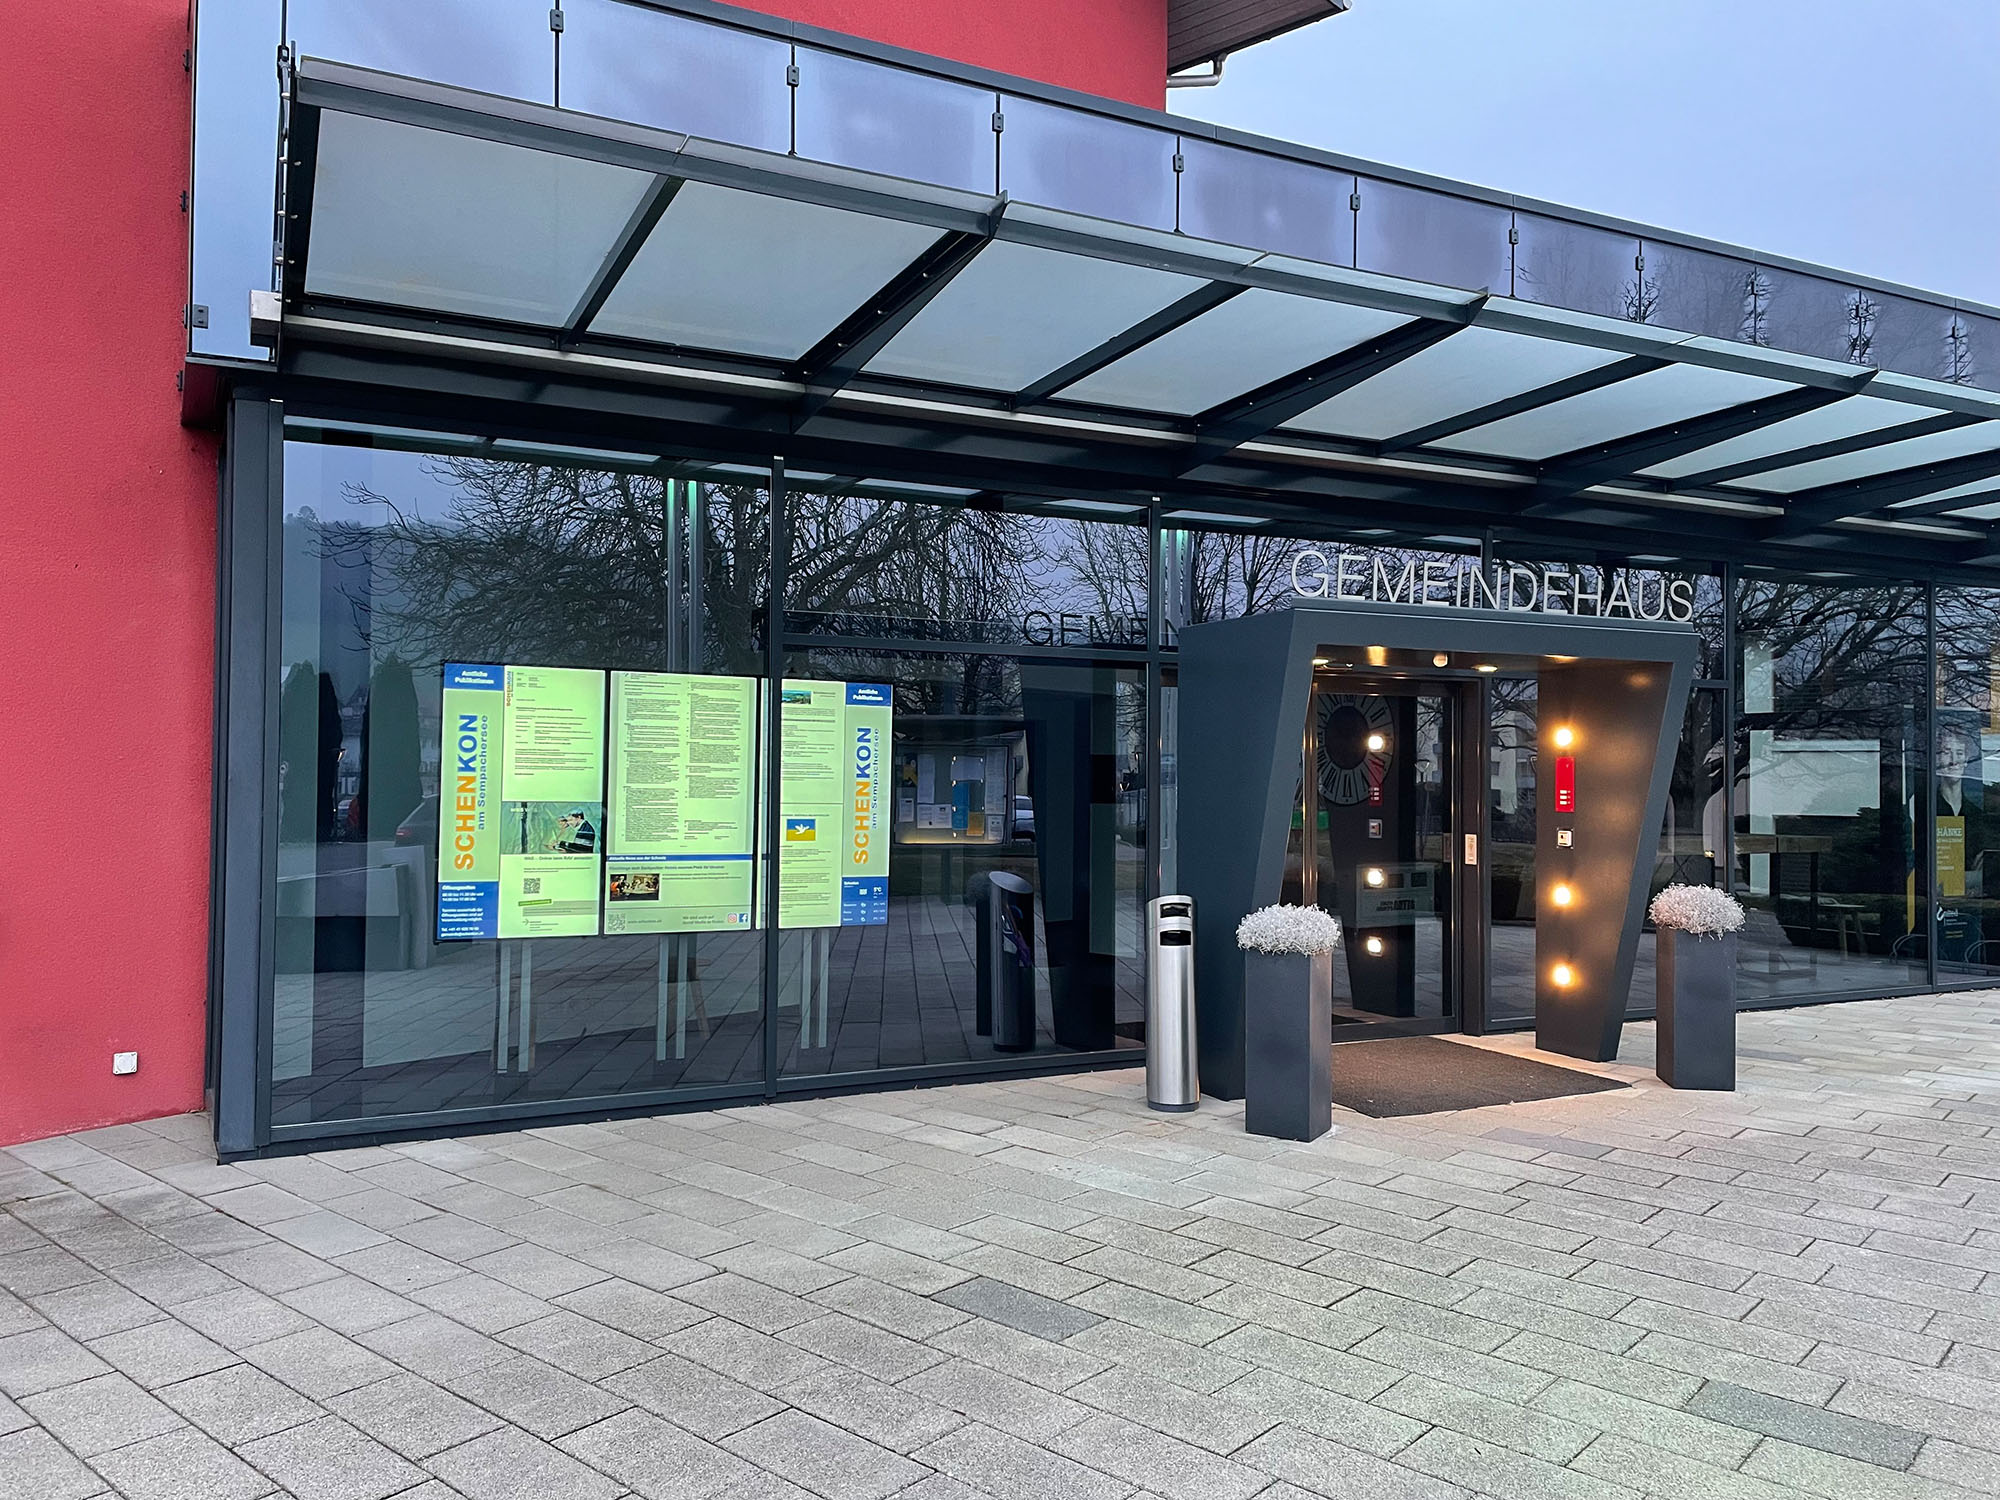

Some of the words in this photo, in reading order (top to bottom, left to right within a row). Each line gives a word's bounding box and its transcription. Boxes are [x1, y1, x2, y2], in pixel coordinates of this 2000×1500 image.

[1291, 550, 1694, 622] GEMEINDEHAUS
[454, 714, 478, 870] SCHENKON
[478, 715, 488, 808] Sempachersee
[853, 727, 872, 865] SCHENKON
[872, 728, 880, 809] Sempachersee
[478, 811, 485, 830] am
[872, 812, 878, 829] am
